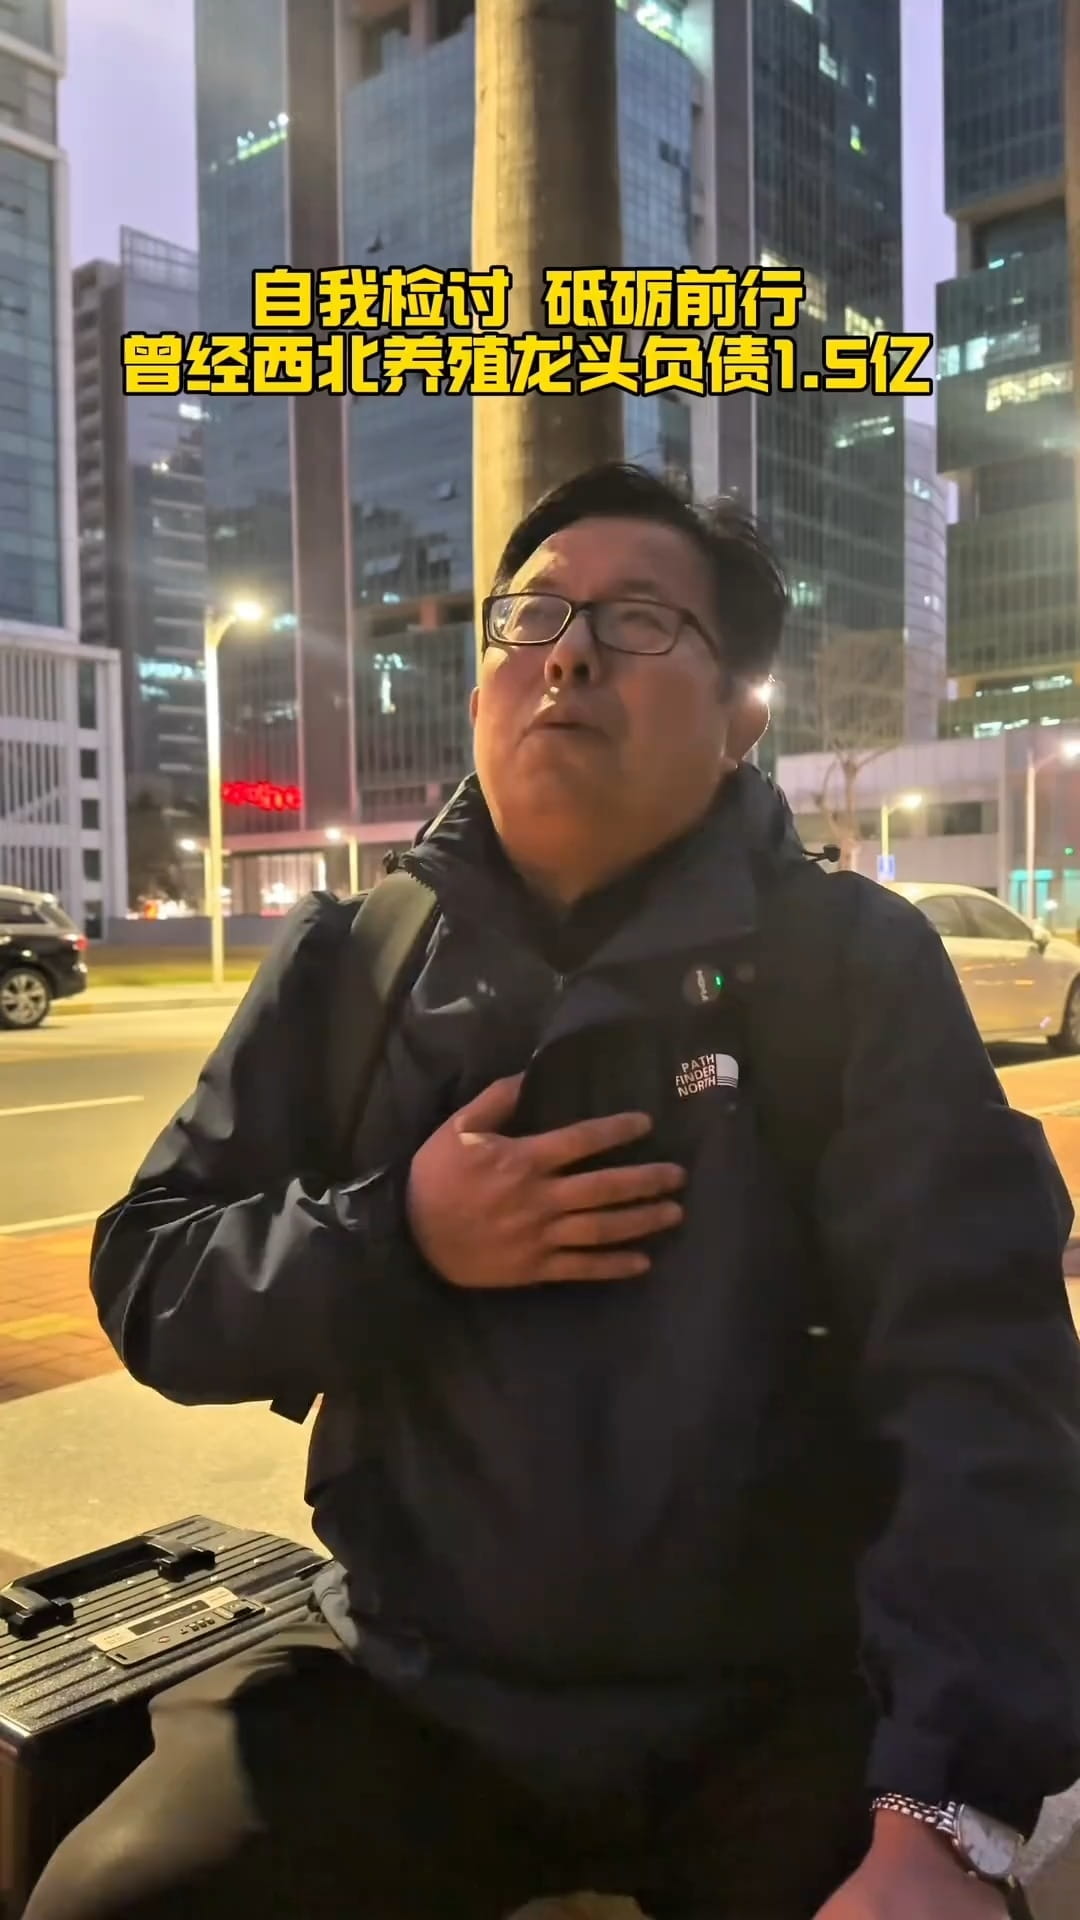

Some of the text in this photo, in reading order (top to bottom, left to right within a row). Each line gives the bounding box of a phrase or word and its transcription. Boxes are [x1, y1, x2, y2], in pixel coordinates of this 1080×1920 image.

[681, 1053, 714, 1073] PATH
[675, 1064, 716, 1087] FINDER
[677, 1075, 716, 1097] NORTH
